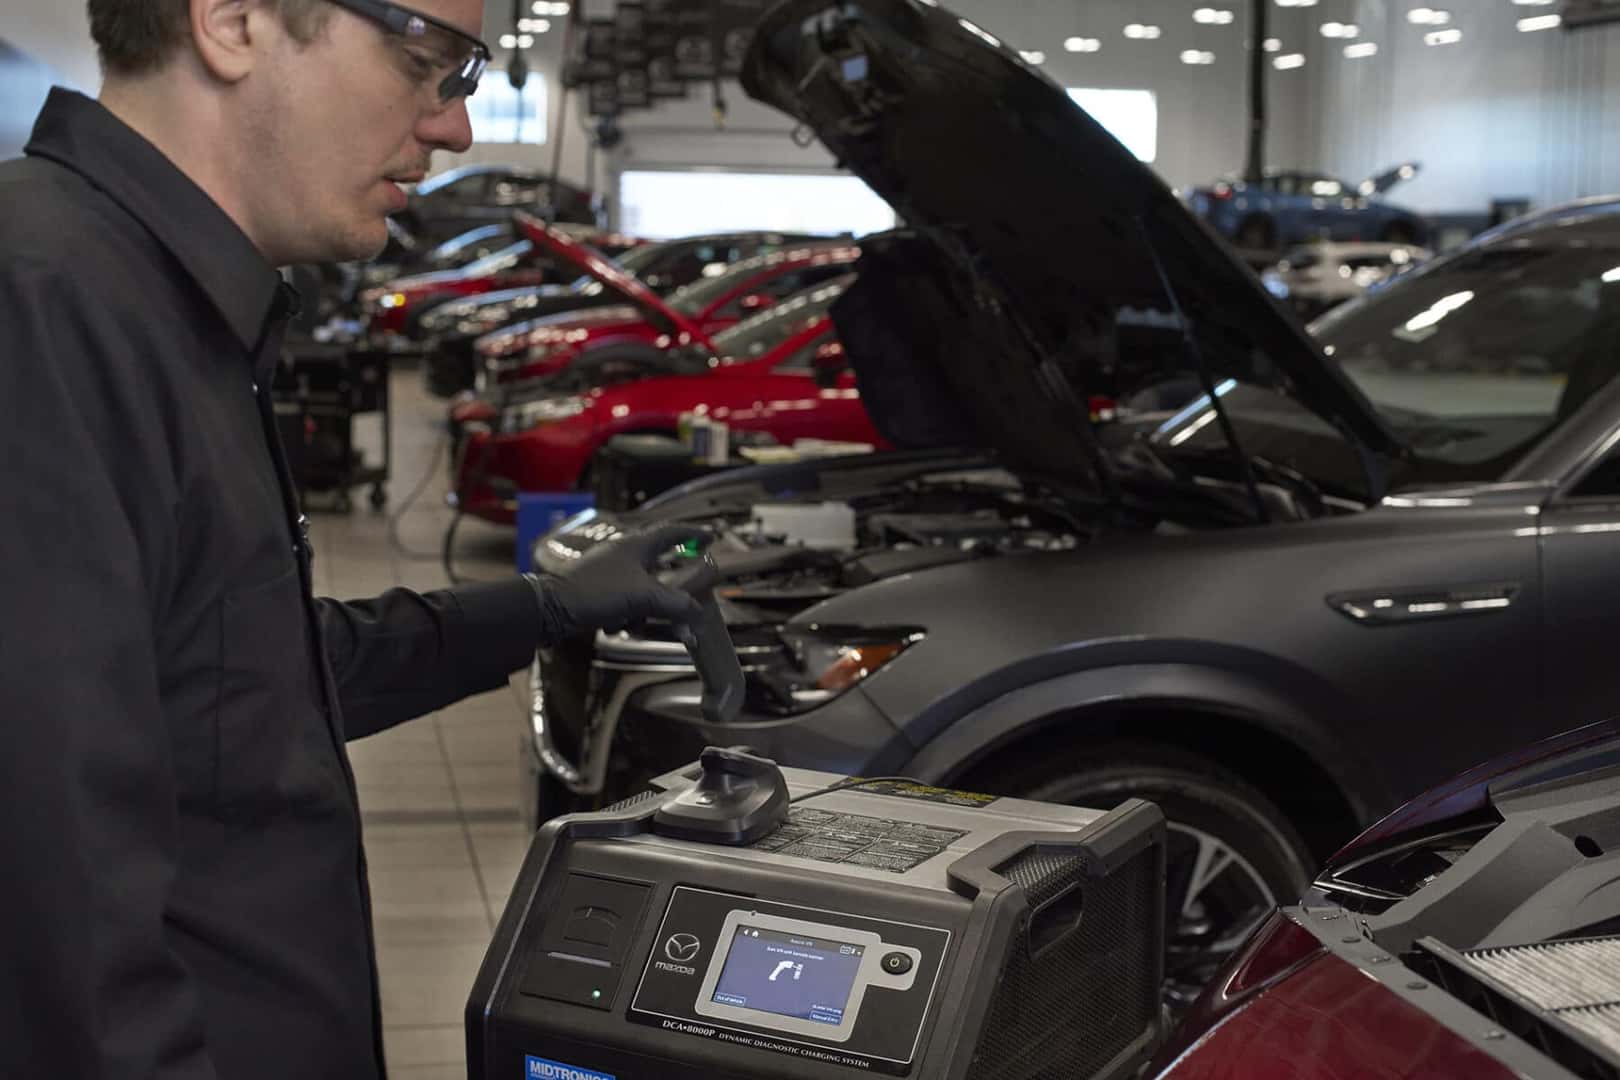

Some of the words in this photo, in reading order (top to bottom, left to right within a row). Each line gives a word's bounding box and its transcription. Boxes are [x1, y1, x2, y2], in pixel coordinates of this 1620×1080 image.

[655, 961, 695, 975] mazda
[718, 1033, 752, 1045] DYNAMIC
[754, 1040, 799, 1054] DIAGNOSTIC
[801, 1049, 840, 1062] CHARGING
[842, 1057, 870, 1068] SYSTEM
